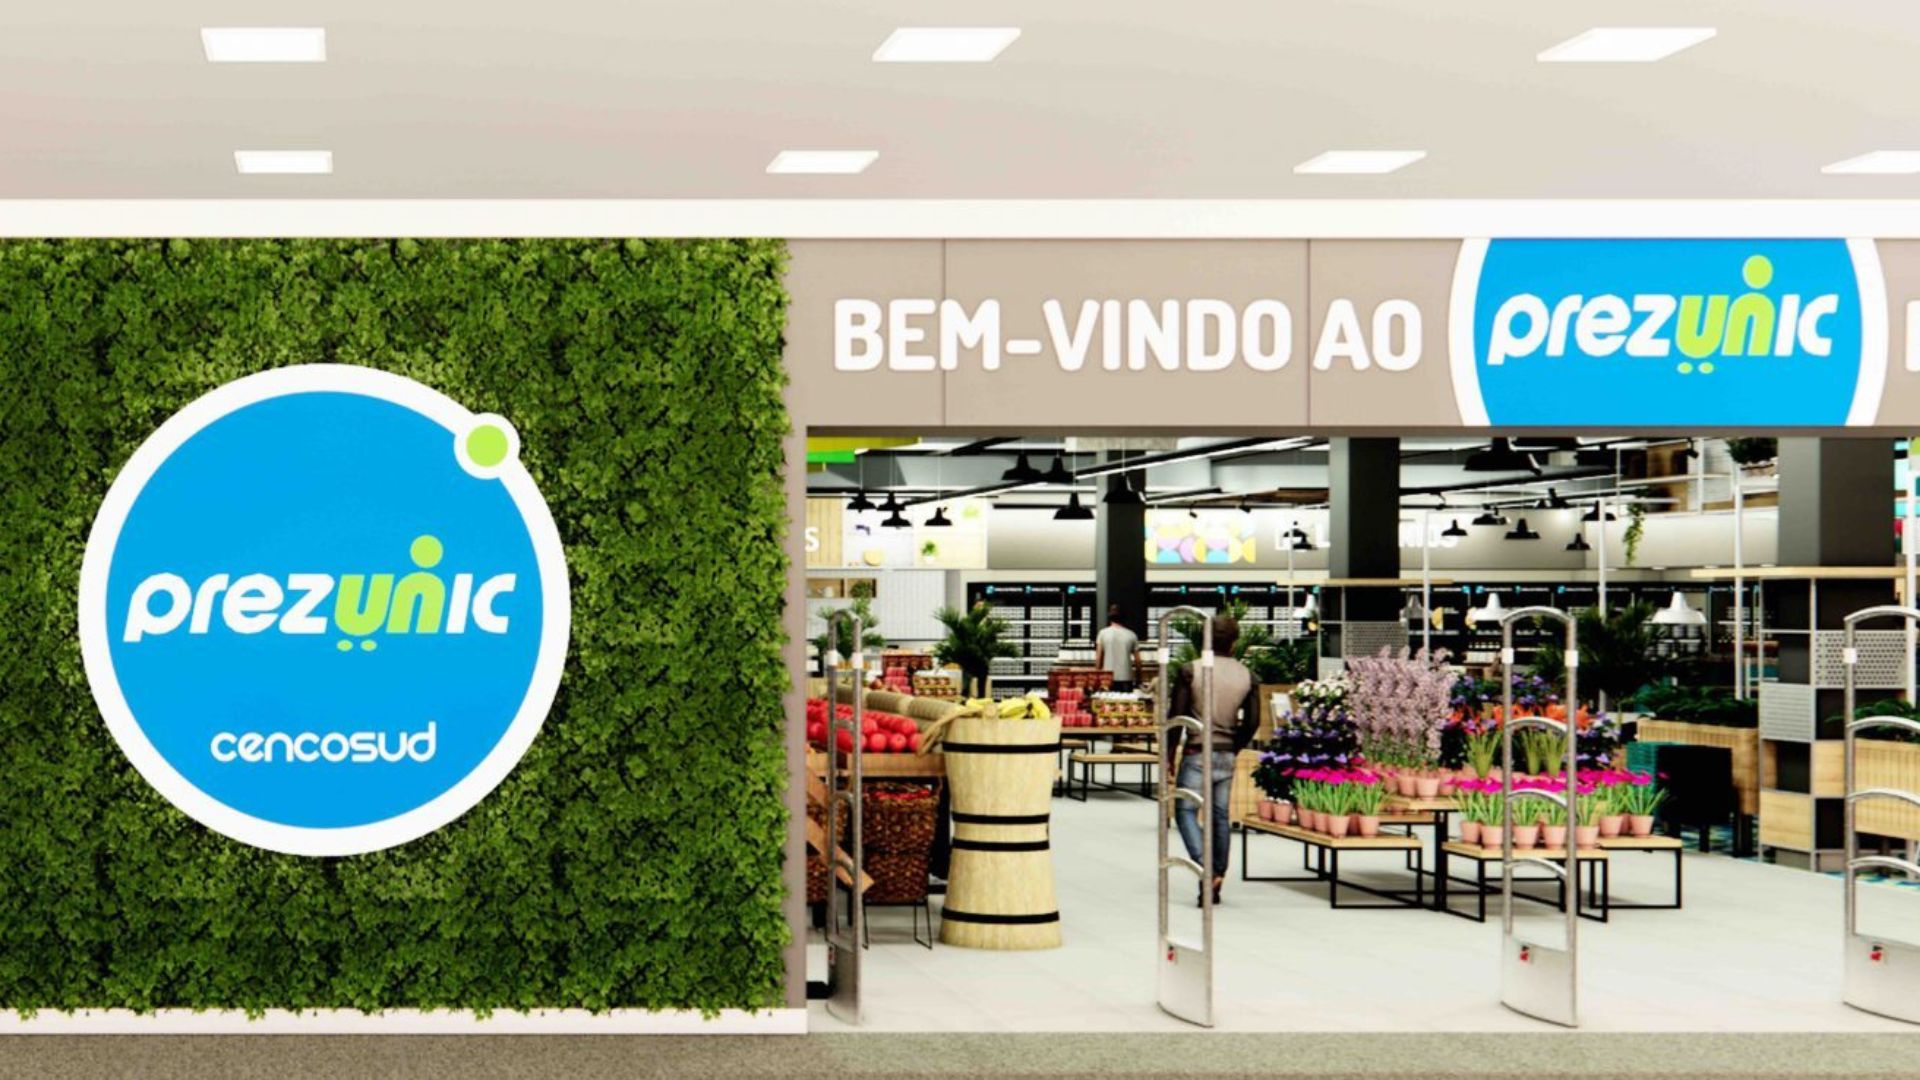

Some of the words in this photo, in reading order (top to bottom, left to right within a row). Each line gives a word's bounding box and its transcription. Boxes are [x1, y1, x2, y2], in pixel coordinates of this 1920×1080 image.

[834, 298, 1292, 371] BEM-VINDO
[1312, 298, 1423, 371] AO
[1487, 255, 1839, 374] prezunic
[123, 534, 517, 652] prezunic
[210, 721, 437, 763] cencosud
